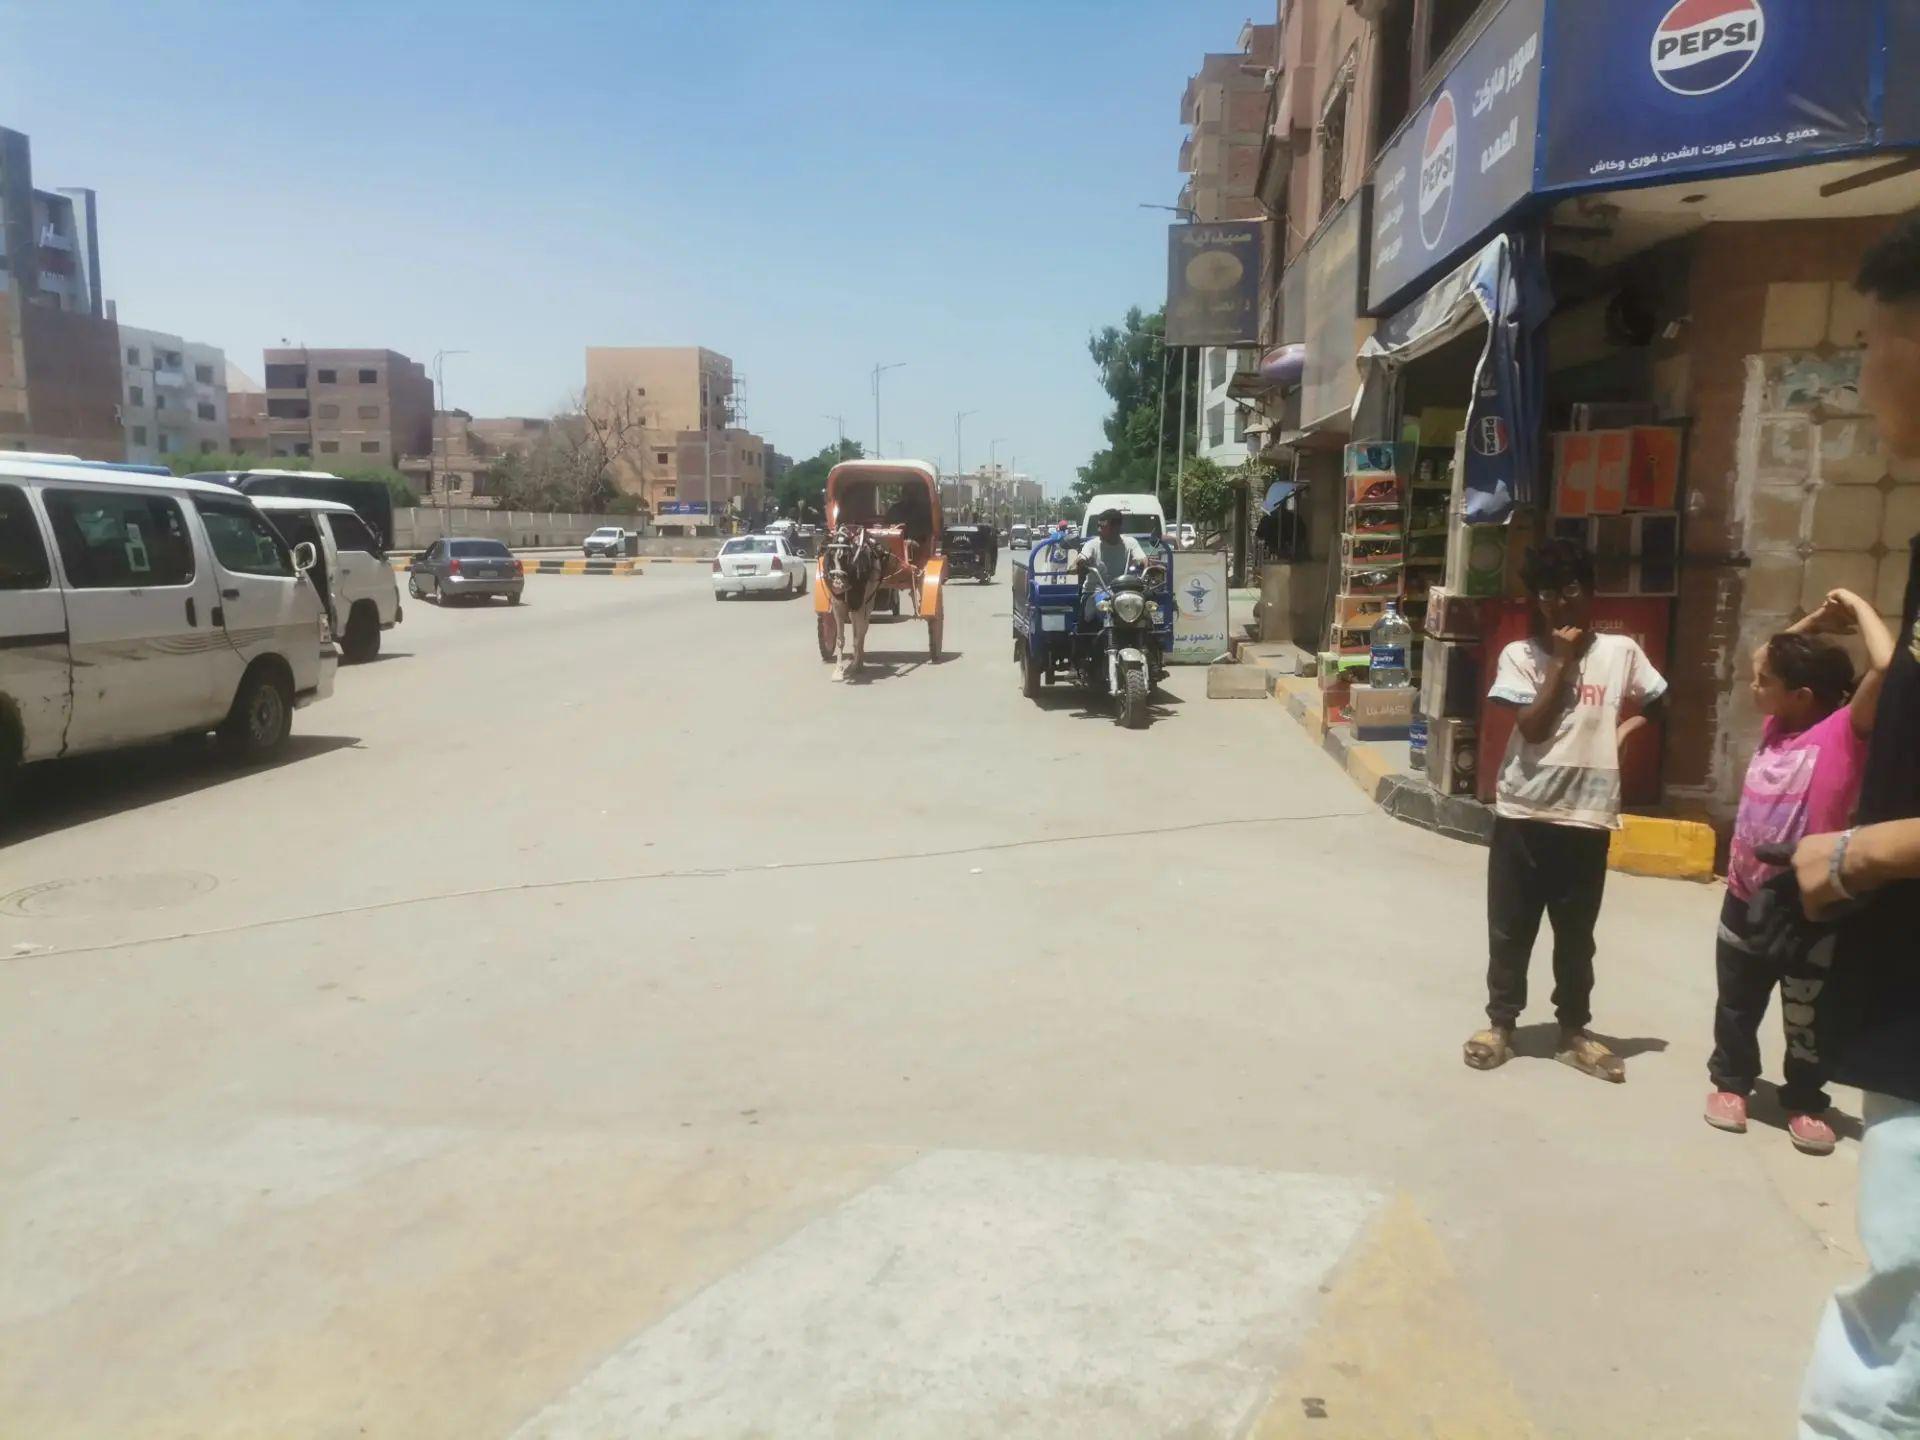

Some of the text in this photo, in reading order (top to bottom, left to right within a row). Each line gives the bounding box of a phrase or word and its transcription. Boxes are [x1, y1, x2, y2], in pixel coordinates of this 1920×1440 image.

[1657, 19, 1757, 61] PEPSI
[1739, 132, 1782, 149] خدمات
[1785, 127, 1820, 145] جميع
[1661, 145, 1699, 163] الشحن
[1701, 140, 1736, 157] كروت
[1422, 144, 1454, 192] PEPSI
[1589, 159, 1625, 175] وكاش
[1485, 418, 1497, 454] PEPSI
